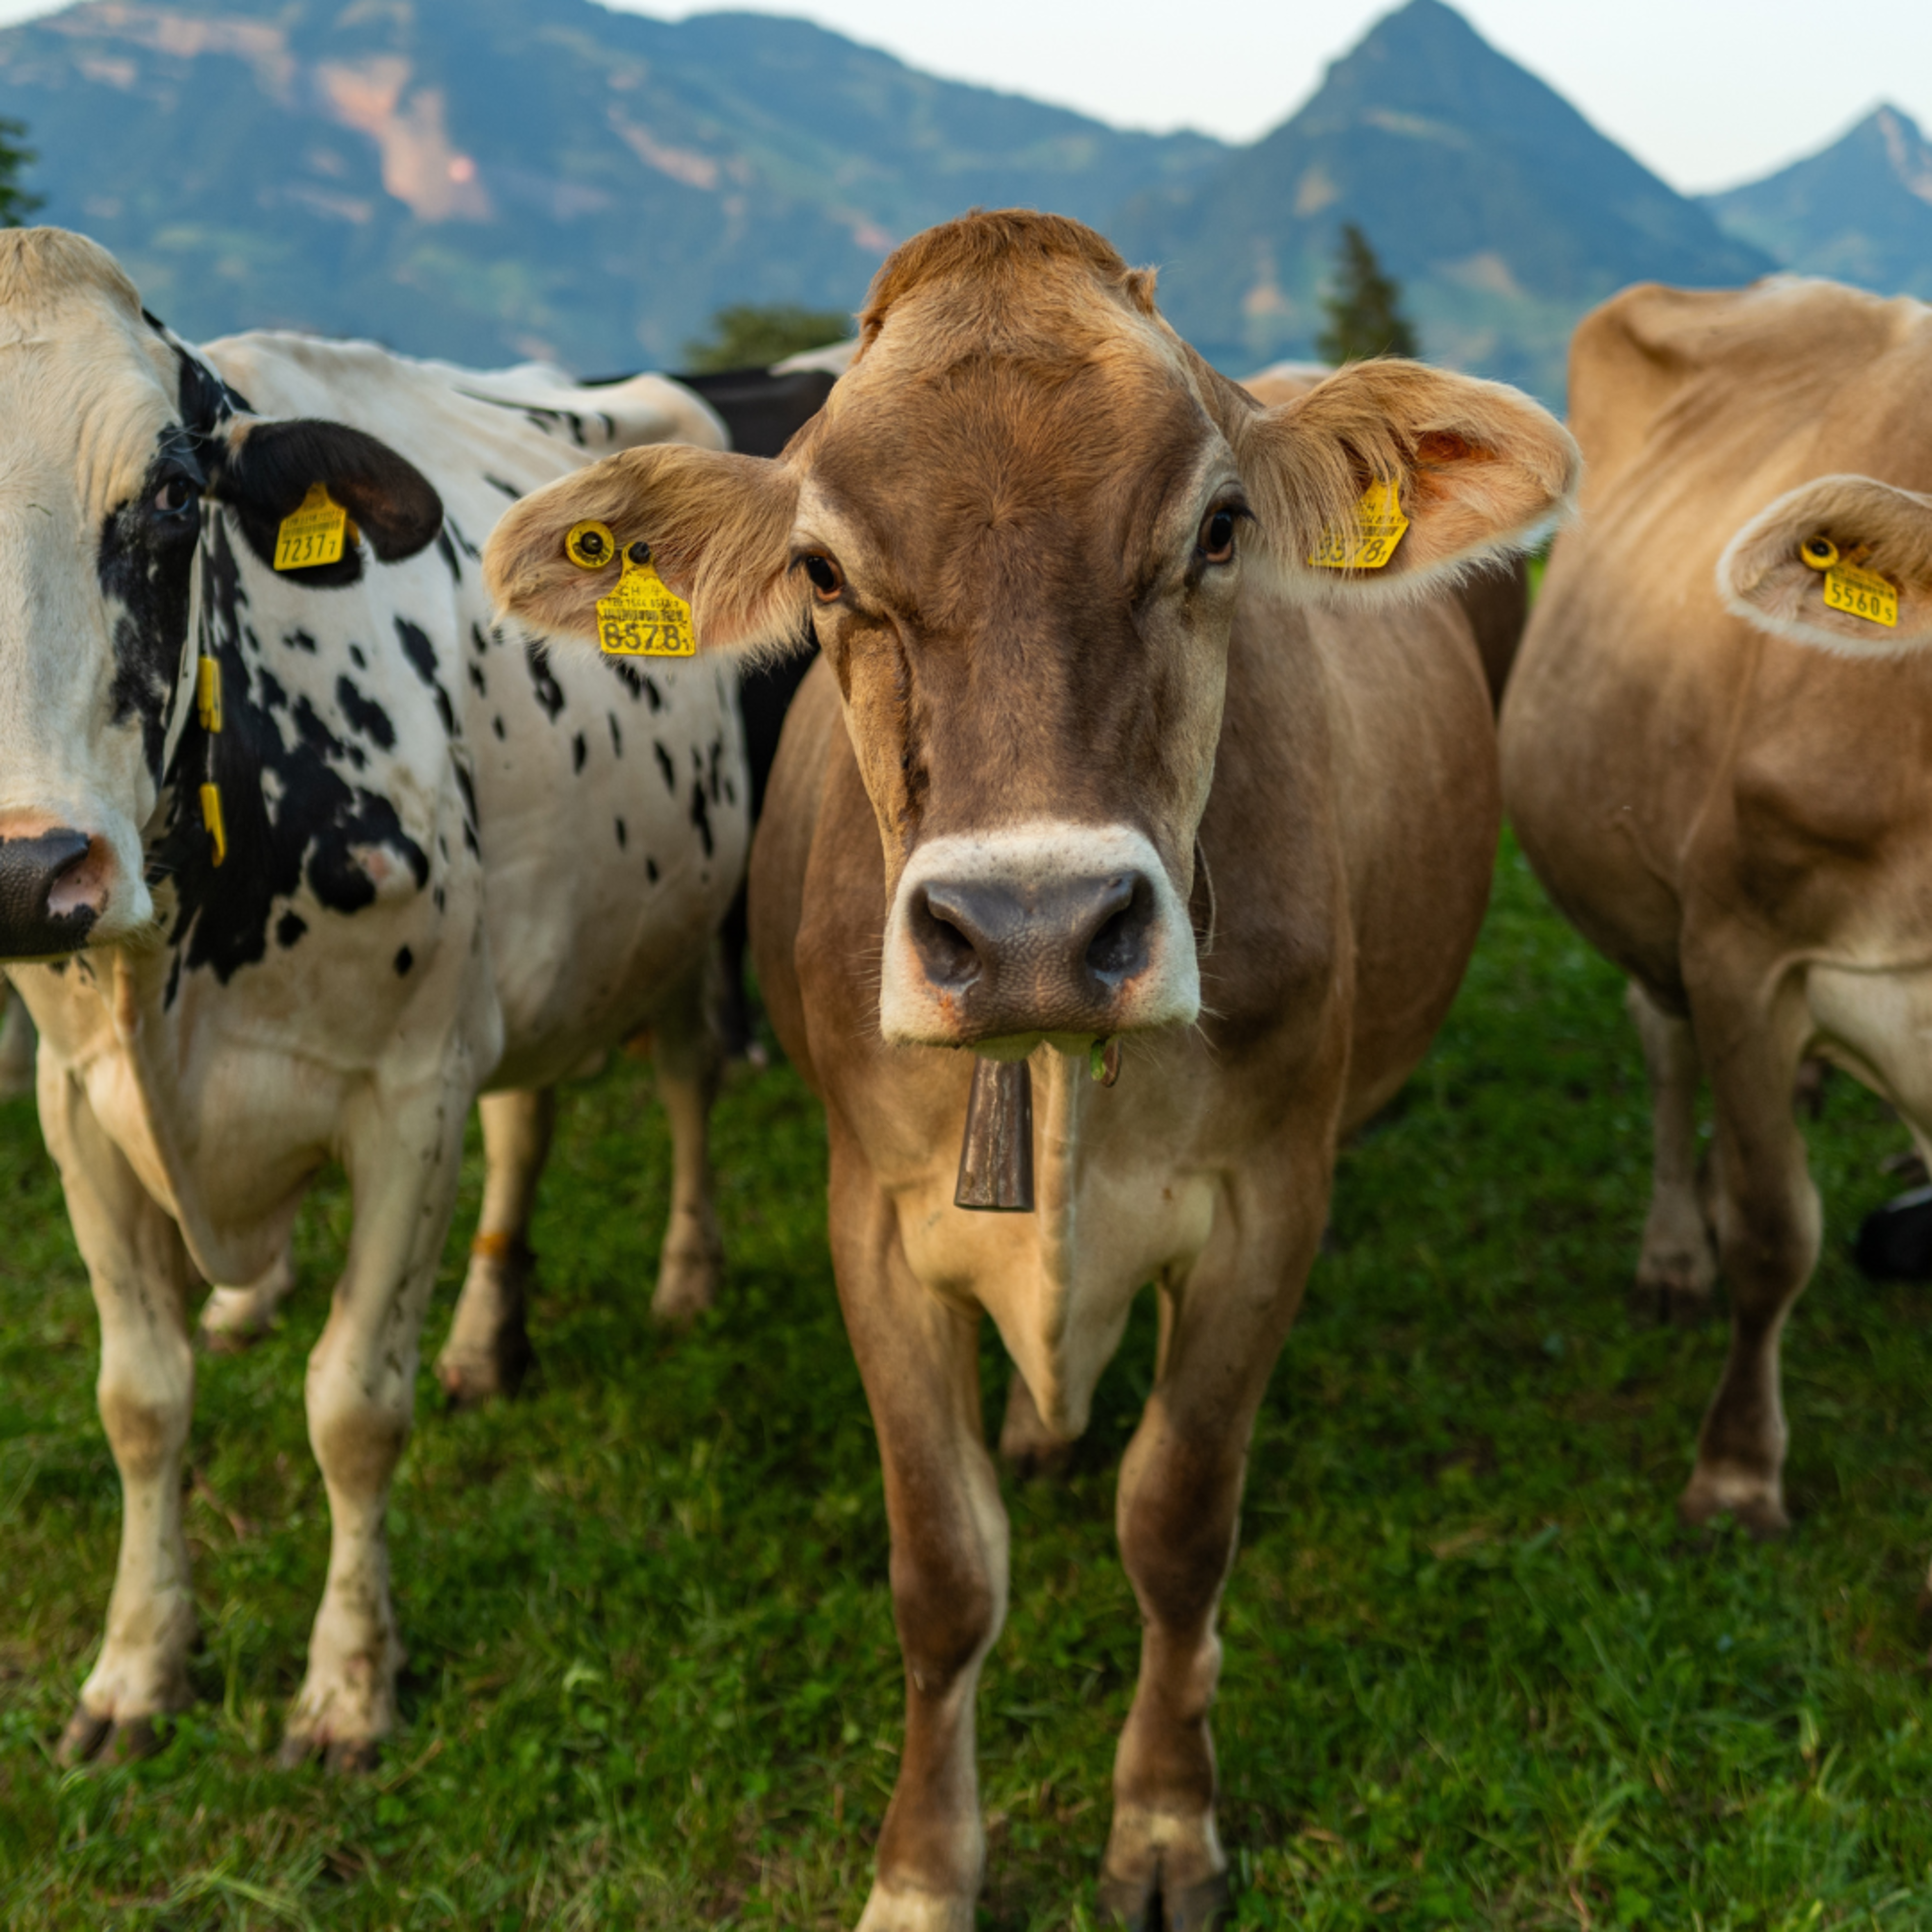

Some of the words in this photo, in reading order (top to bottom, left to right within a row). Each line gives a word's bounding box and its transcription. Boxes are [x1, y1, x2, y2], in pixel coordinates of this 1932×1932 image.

[282, 534, 326, 564] 7237
[1831, 582, 1880, 617] 5560
[603, 622, 681, 651] 8578
